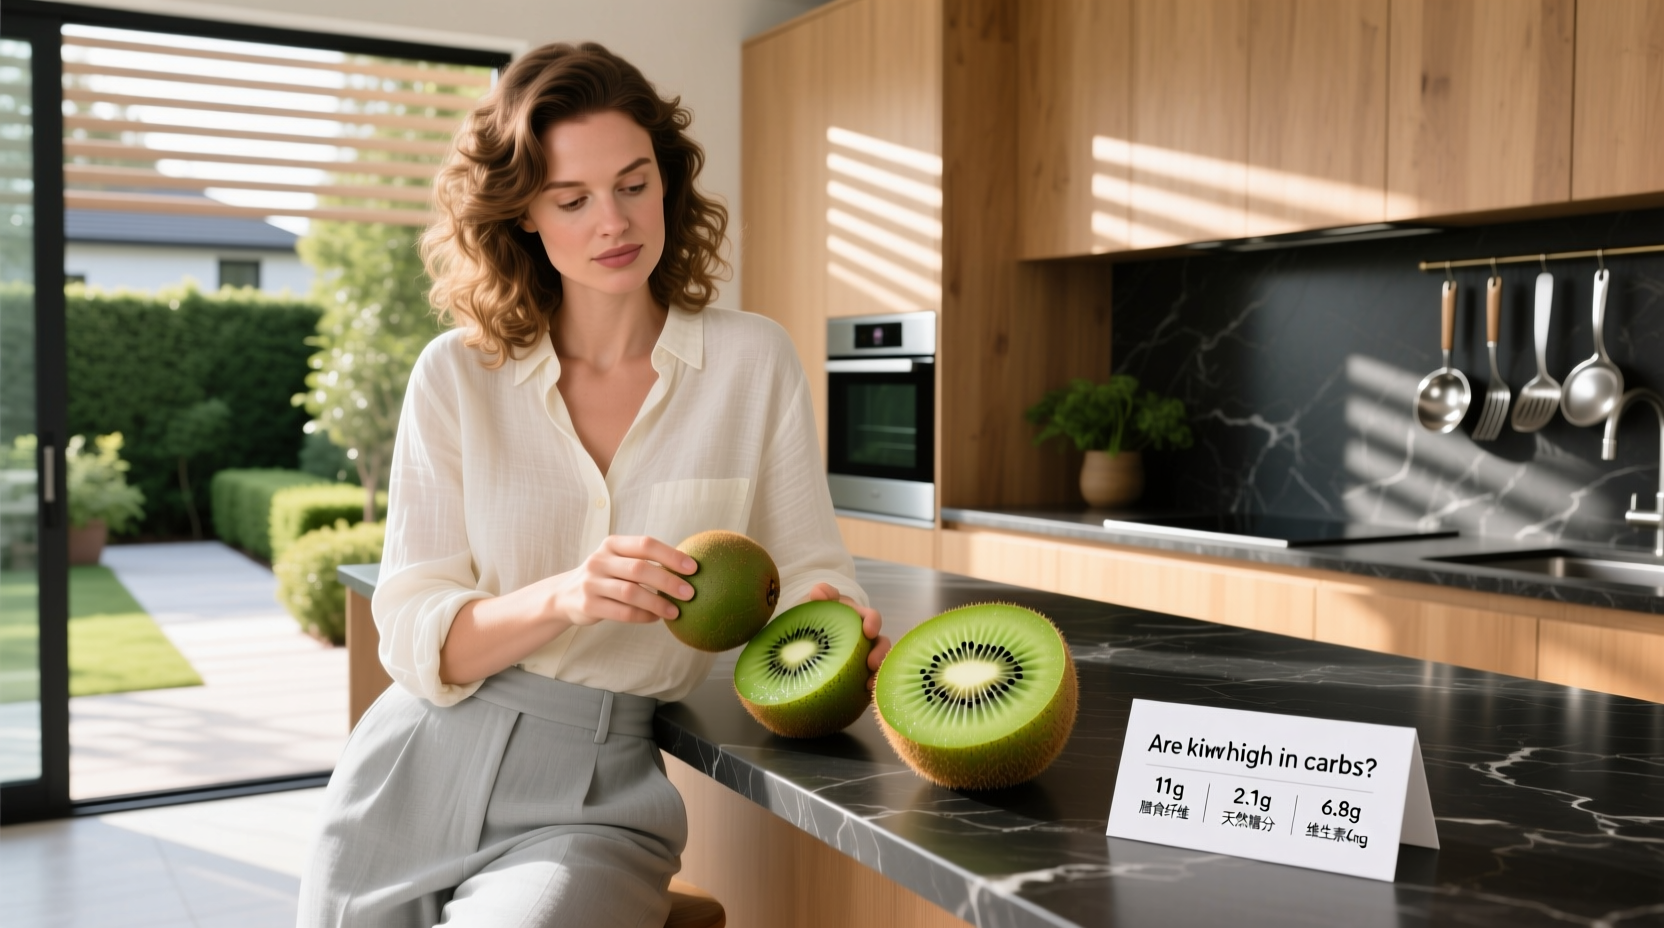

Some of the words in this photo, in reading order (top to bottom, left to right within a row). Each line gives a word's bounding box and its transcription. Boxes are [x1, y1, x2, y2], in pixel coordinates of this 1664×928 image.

[1147, 734, 1183, 755] Are
[1279, 747, 1298, 769] in
[1304, 753, 1378, 778] carbs?
[1155, 776, 1184, 801] 11g
[1233, 787, 1272, 812] 2.1g
[1321, 799, 1361, 824] 6.8g
